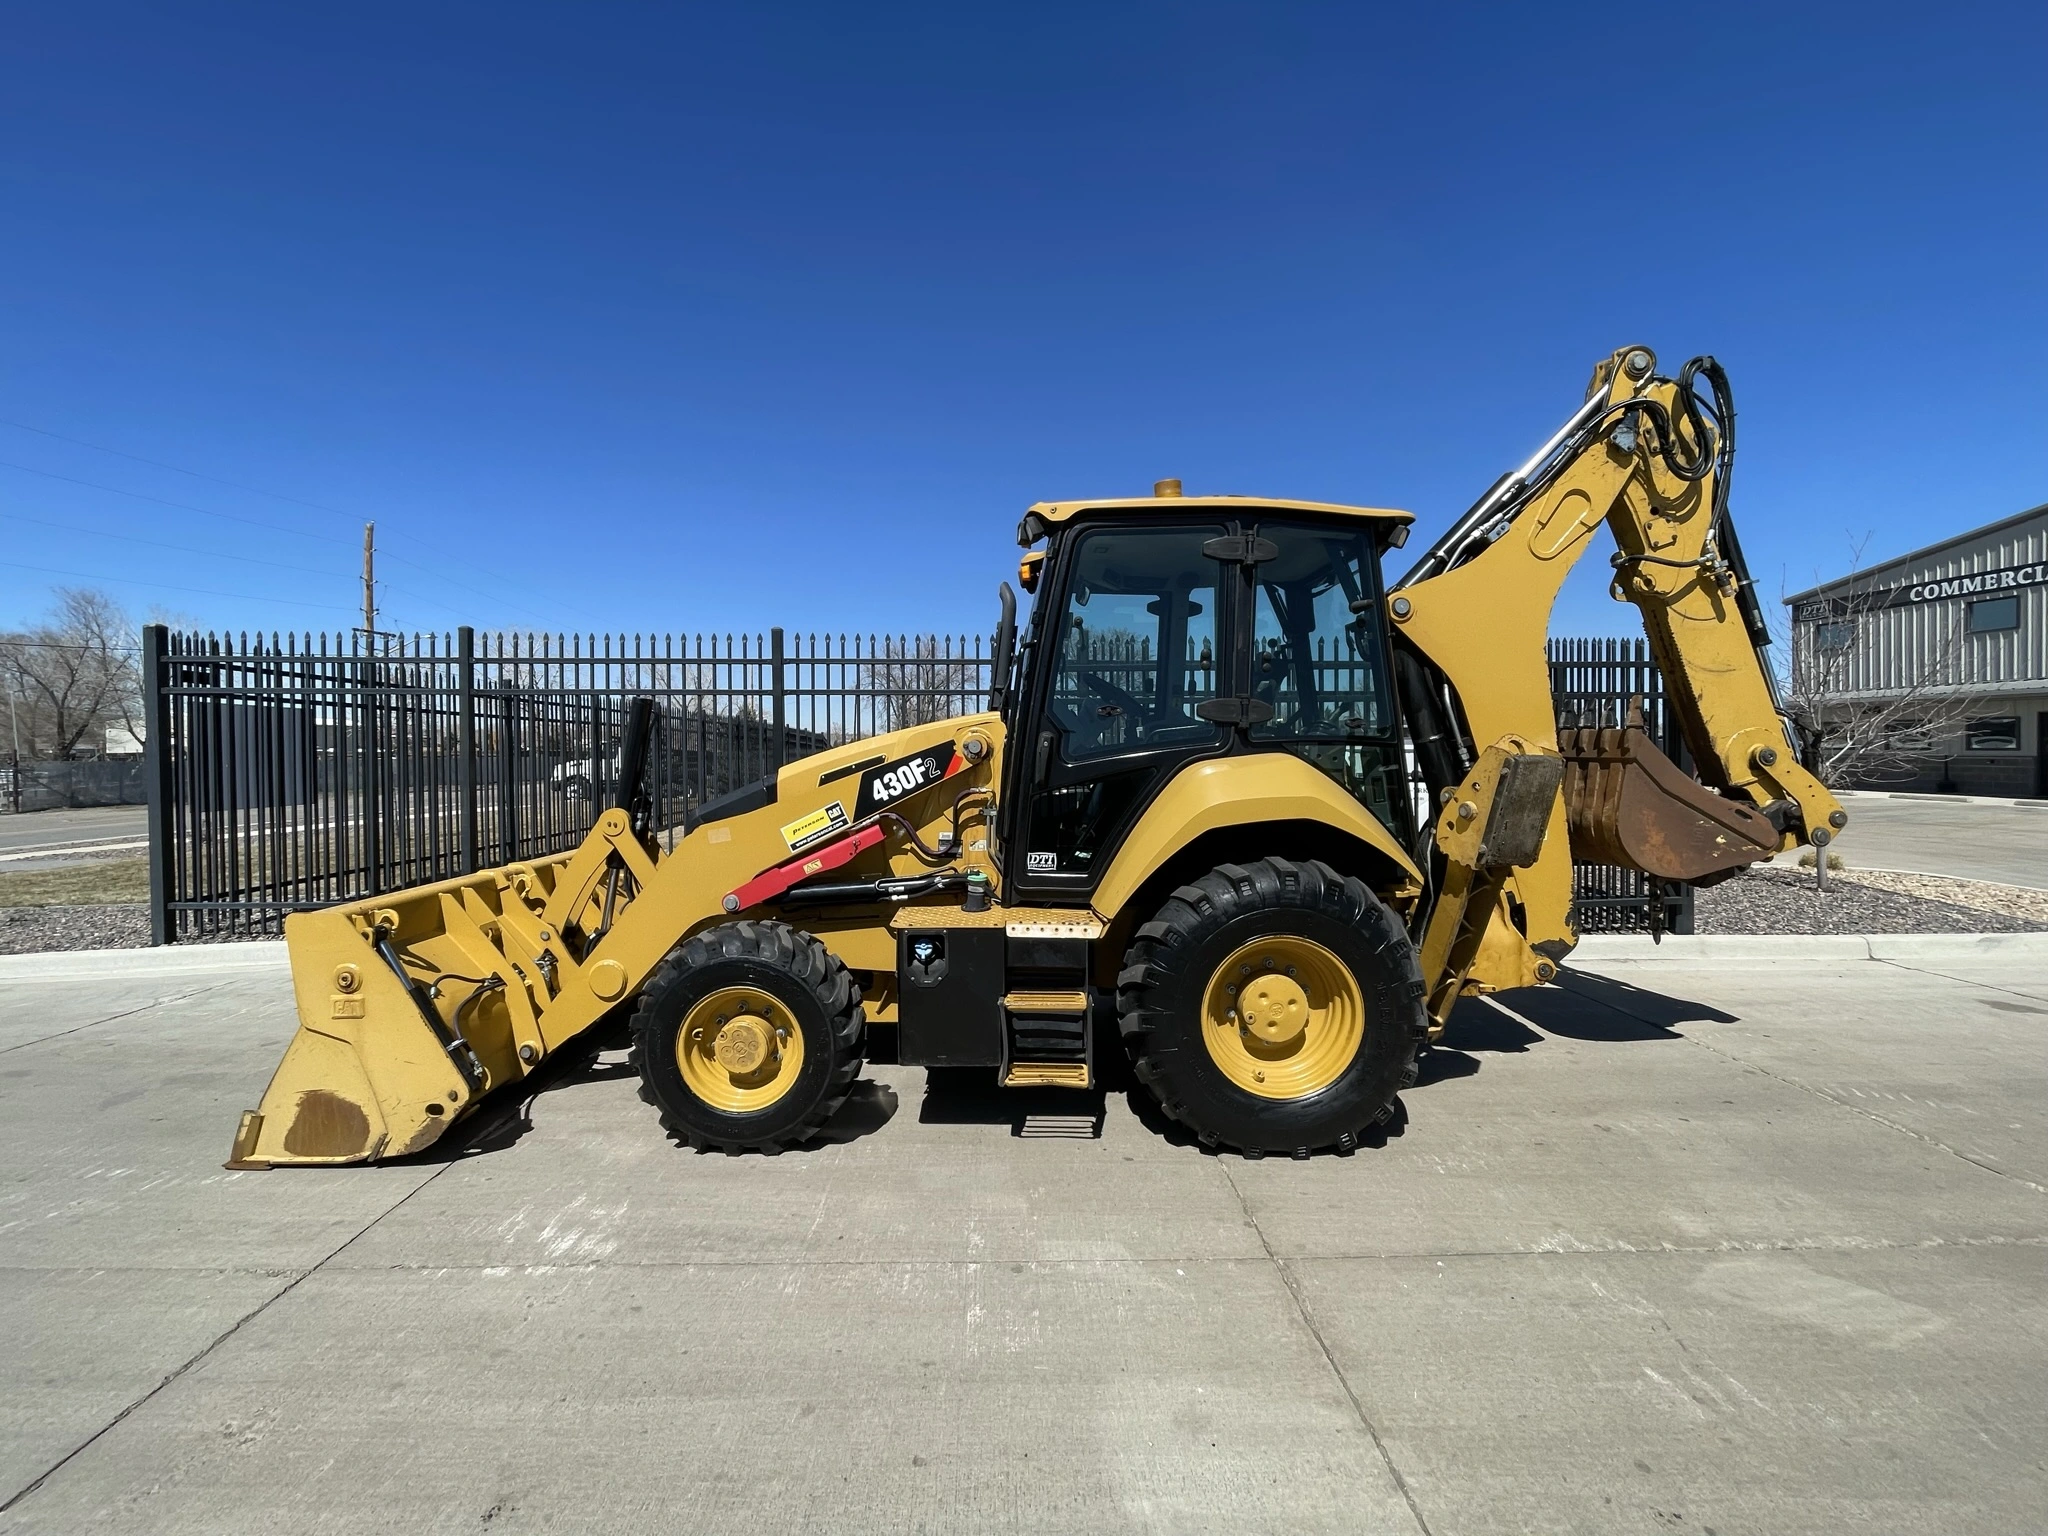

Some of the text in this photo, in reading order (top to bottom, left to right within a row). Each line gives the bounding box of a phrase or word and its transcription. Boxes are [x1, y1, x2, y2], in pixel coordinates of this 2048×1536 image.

[1909, 565, 2048, 602] COMMERCI
[873, 757, 941, 802] 430F2
[827, 806, 842, 819] CAT
[1029, 854, 1054, 864] DTI
